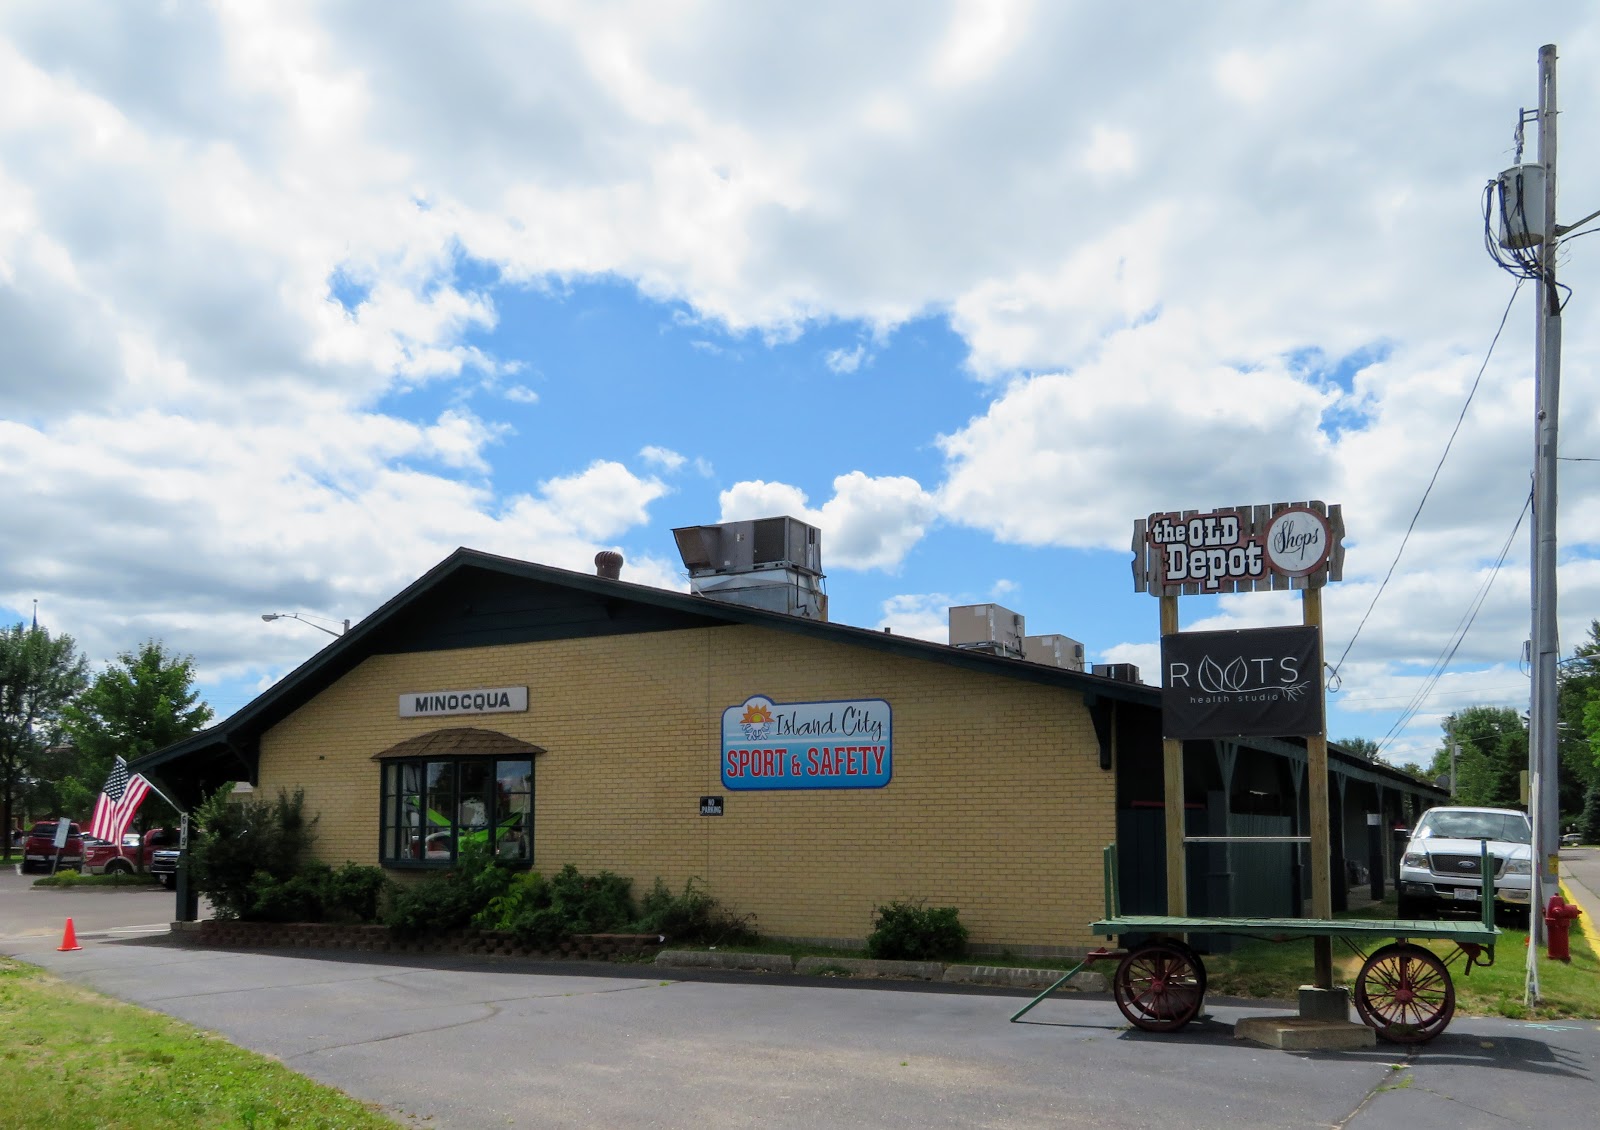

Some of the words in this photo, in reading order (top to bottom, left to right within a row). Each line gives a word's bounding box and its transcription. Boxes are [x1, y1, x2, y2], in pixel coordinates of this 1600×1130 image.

[1153, 519, 1186, 543] the
[1188, 516, 1240, 547] OLD
[1273, 520, 1319, 560] Shops
[1166, 541, 1263, 589] Depot
[1170, 655, 1299, 693] ROOTS
[415, 692, 510, 712] MINOCQUA
[1190, 695, 1230, 704] health
[1238, 693, 1279, 702] studio
[776, 711, 837, 736] Island
[841, 705, 883, 742] City
[726, 748, 787, 777] SPORT
[791, 754, 802, 776] &
[807, 746, 886, 775] SAFETY
[707, 798, 715, 806] NO
